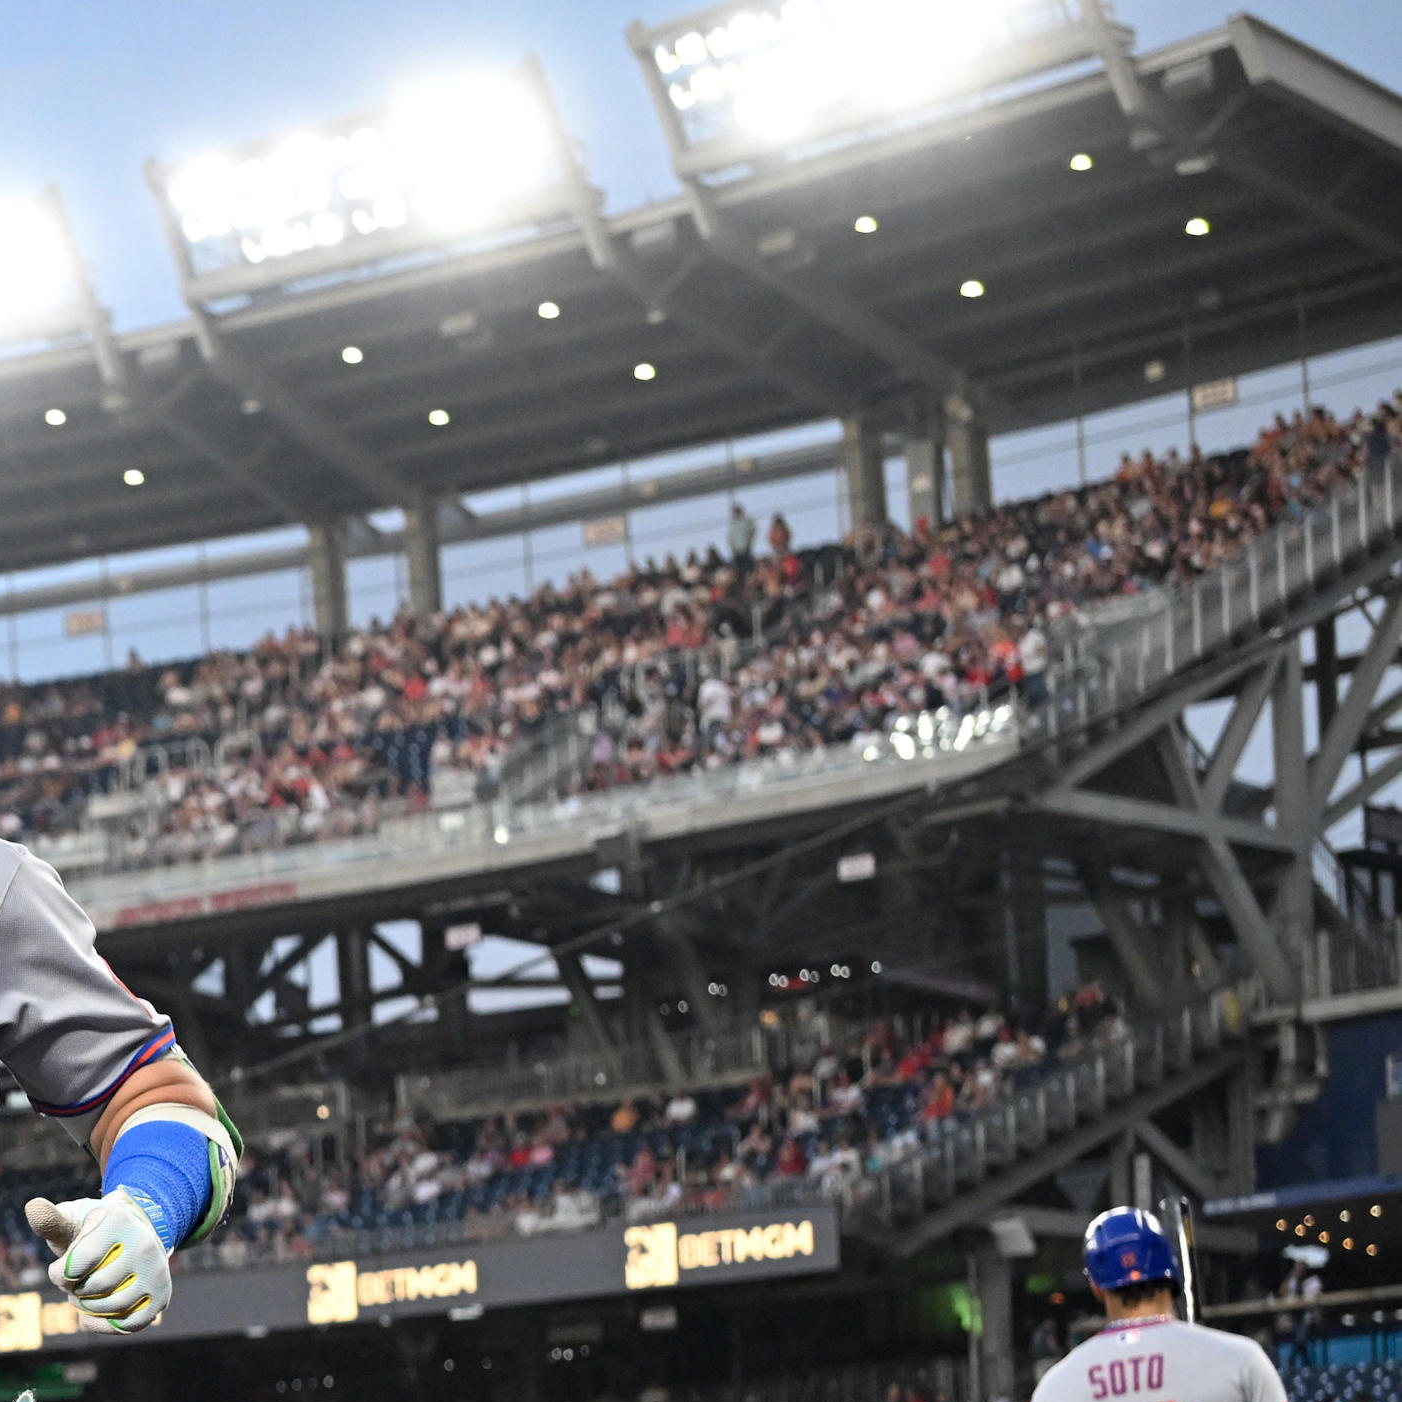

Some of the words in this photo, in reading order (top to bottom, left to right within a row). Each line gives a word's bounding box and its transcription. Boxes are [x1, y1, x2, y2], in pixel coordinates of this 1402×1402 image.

[678, 1220, 814, 1269] BETMGM
[358, 1259, 477, 1306] BETMGM
[1088, 1353, 1165, 1400] SOTO
